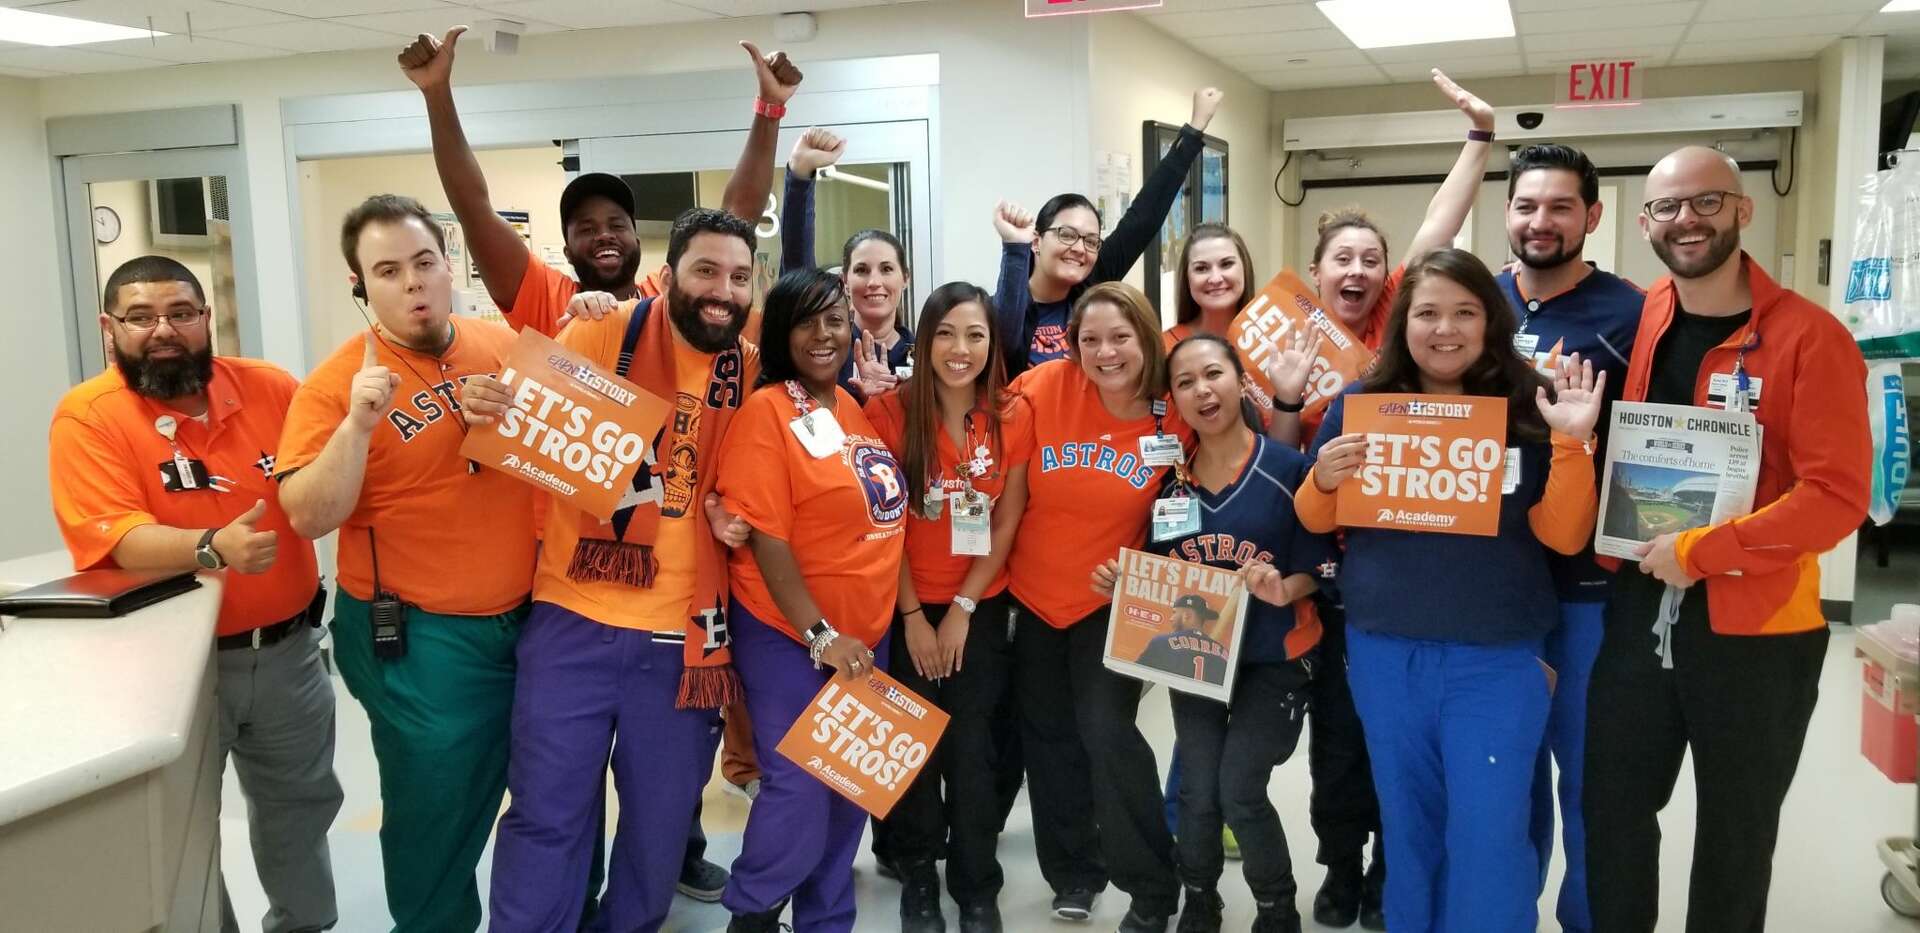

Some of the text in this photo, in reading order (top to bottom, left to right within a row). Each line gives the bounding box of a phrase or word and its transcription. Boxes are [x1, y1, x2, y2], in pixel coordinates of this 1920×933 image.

[1569, 61, 1635, 101] EXIT
[1619, 411, 1751, 437] HOUSTON CHRONICLE
[591, 421, 644, 465] GO
[1365, 432, 1501, 471] ET'S GO
[1621, 449, 1716, 470] The comforts of home
[520, 461, 579, 496] Academy
[1042, 441, 1155, 490] ASTROS
[1395, 509, 1456, 527] Academy
[1129, 553, 1182, 586] LET'S
[1125, 575, 1179, 608] BALL!
[1193, 656, 1205, 681] 1
[816, 683, 927, 769] LET'S GO
[821, 764, 865, 797] Academy
